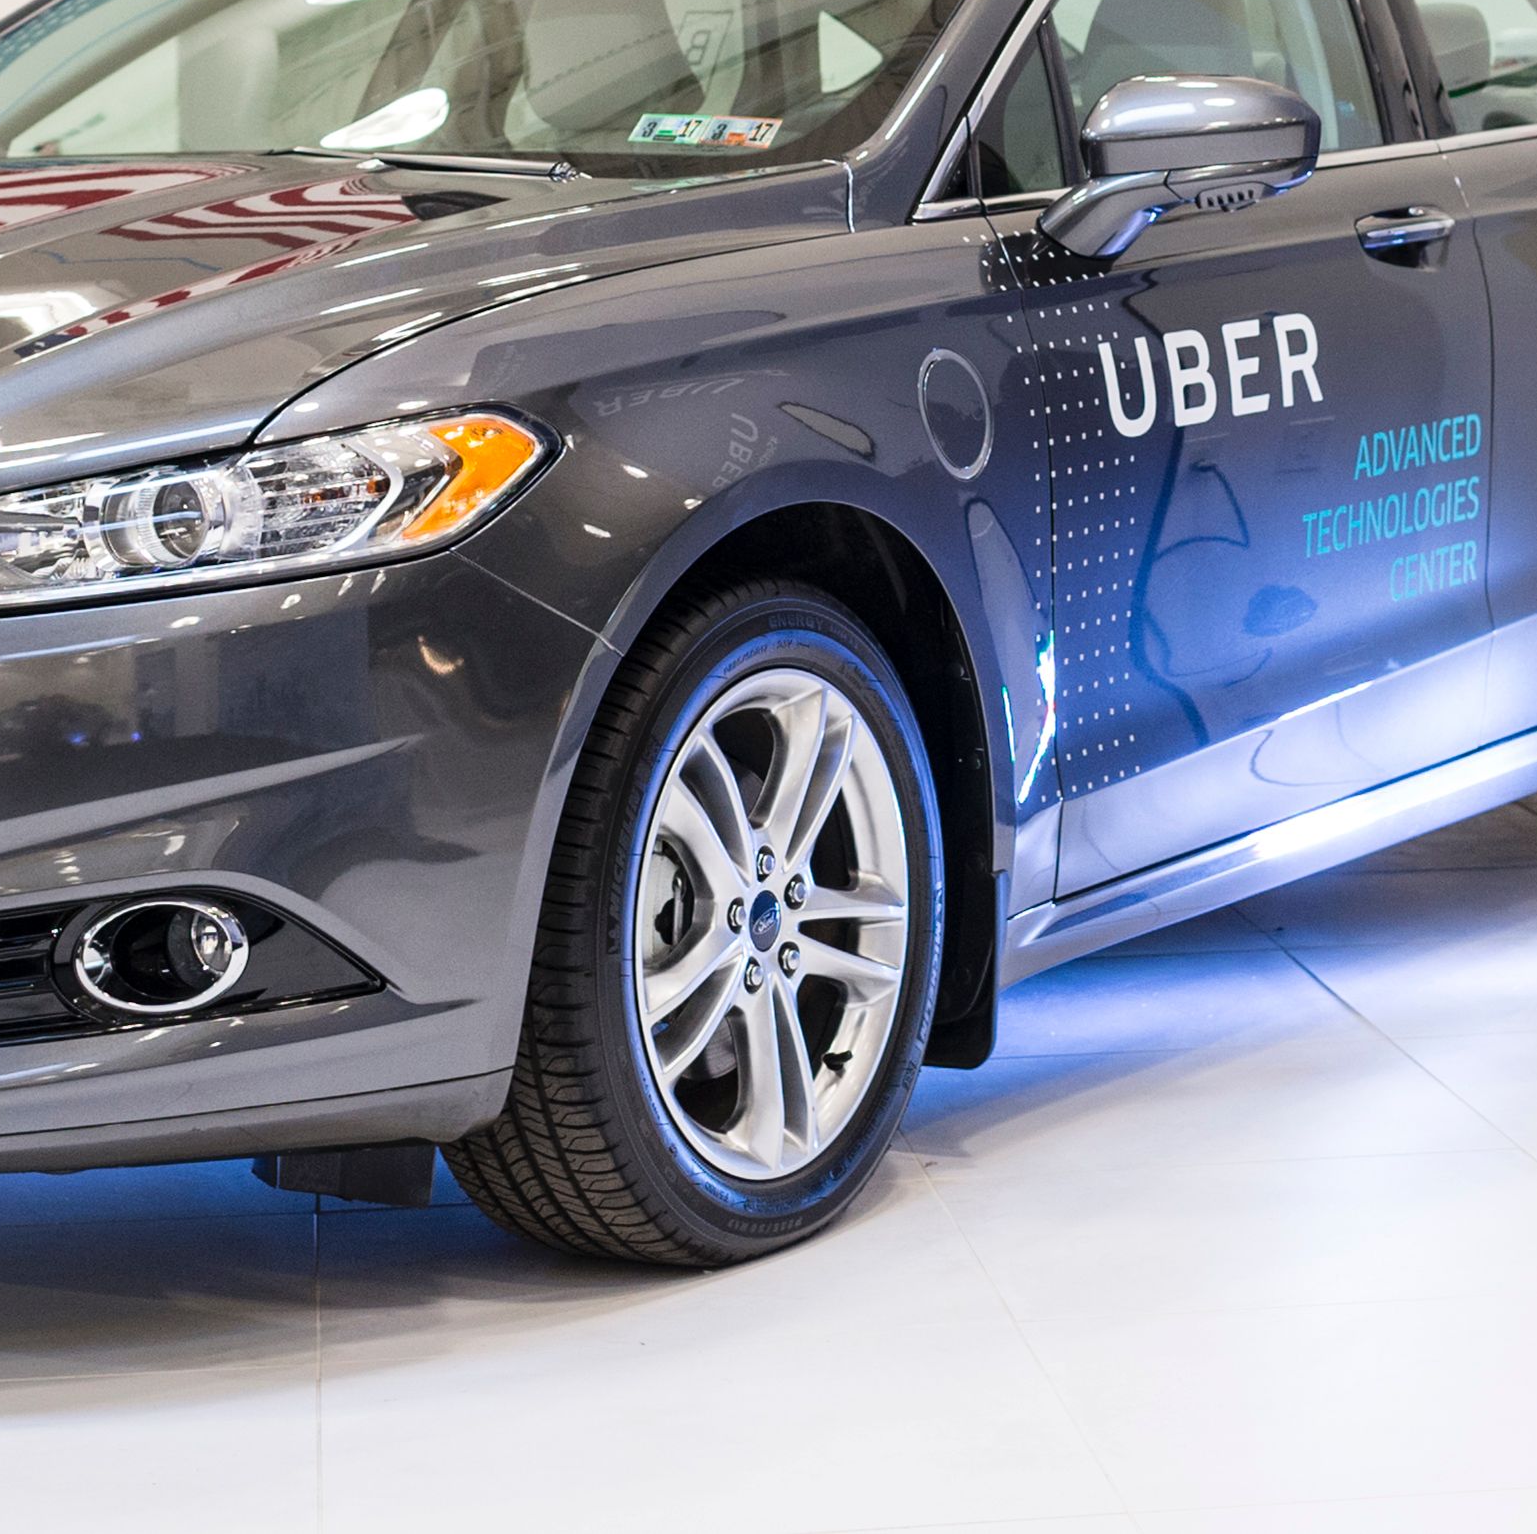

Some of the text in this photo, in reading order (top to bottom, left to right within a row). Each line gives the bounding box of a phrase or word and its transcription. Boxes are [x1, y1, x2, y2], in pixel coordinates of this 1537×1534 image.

[642, 119, 703, 138] 3 17
[711, 123, 774, 142] 3 17
[1097, 313, 1324, 438] UBER
[1354, 413, 1482, 481] ADVANCED
[1302, 475, 1480, 558] TECHNOLOGIES
[1389, 539, 1477, 603] CENTER
[768, 614, 825, 632] ENERGY
